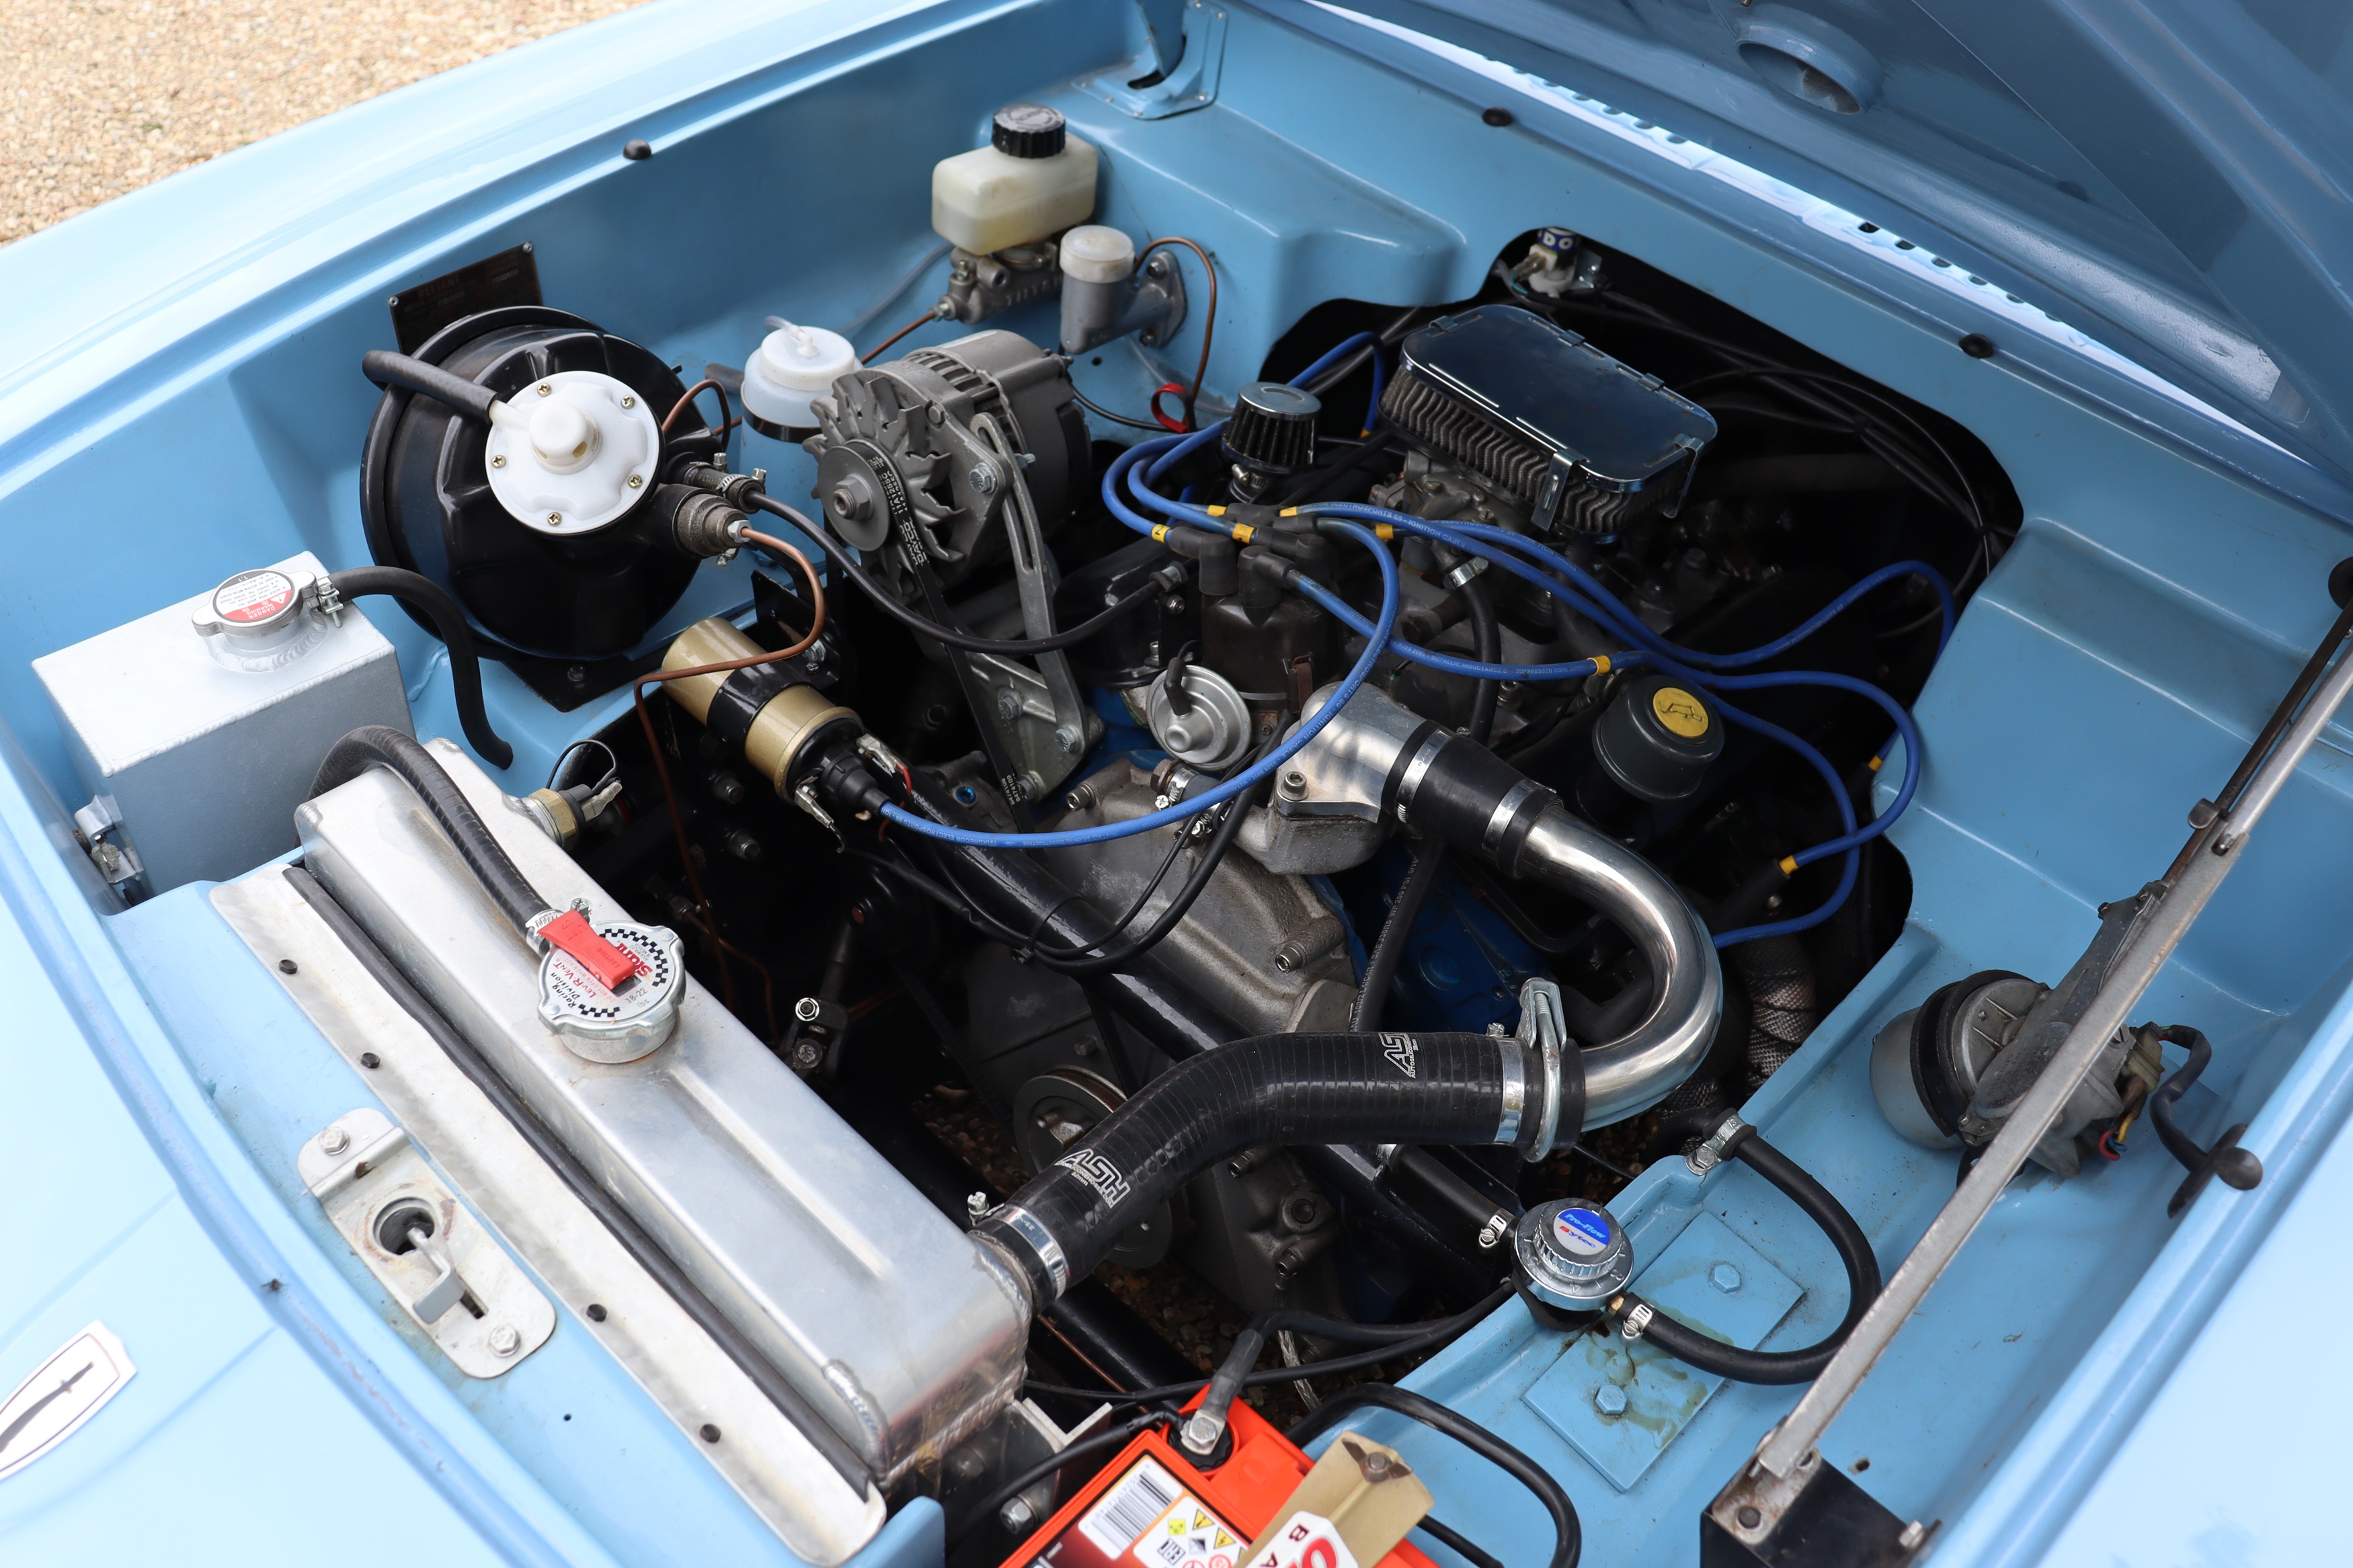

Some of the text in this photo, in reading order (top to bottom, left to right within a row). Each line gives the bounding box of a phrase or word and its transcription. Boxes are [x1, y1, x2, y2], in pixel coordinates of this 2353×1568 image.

[1407, 520, 1441, 538] IGNITION
[903, 522, 925, 563] DAYCO
[246, 602, 273, 615] WARNING
[247, 606, 275, 619] DANGER
[1343, 638, 1385, 698] ELECTROSPORTS
[1302, 710, 1334, 741] IGNITION
[1278, 738, 1305, 759] CABLE
[1006, 774, 1021, 802] 8474109
[902, 817, 955, 841] ELECTROSPORTS
[1371, 942, 1383, 959] SAE
[1377, 918, 1393, 942] J30R6
[1388, 904, 1399, 919] WP
[1394, 889, 1405, 905] 200
[1400, 875, 1411, 891] PSI
[564, 958, 574, 966] HOT
[596, 947, 620, 968] CAUTION
[573, 964, 587, 977] WHEN
[586, 977, 598, 987] OPEN
[551, 971, 580, 999] Division
[551, 985, 577, 1008] Racing
[596, 987, 607, 995] NOT
[625, 987, 647, 1003] 18-22
[1056, 1148, 1131, 1204] ASH
[1559, 1225, 1597, 1249] Sytec
[1564, 1213, 1607, 1239] Pro-Flow
